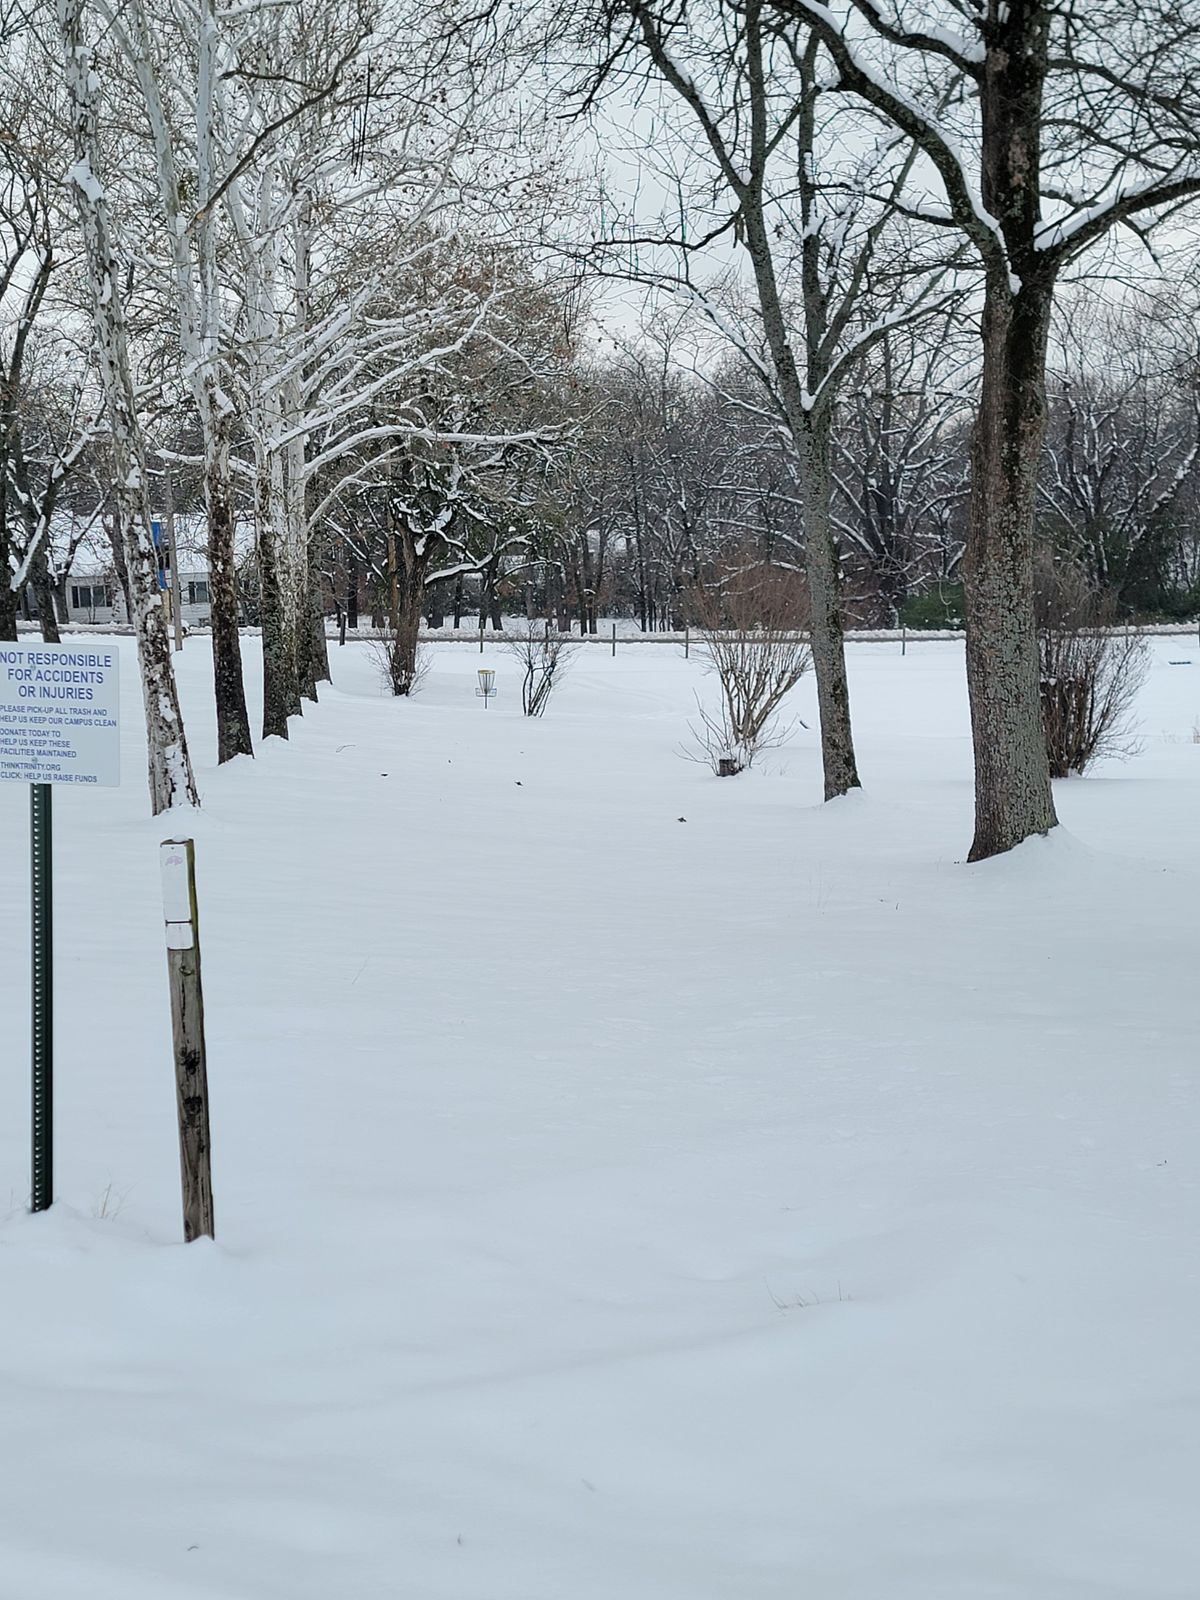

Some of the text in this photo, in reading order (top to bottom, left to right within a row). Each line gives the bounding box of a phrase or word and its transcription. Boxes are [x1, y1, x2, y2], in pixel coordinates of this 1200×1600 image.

[0, 651, 112, 668] NOT RESPONSIBLE
[8, 668, 104, 684] FOR ACCIDENTS
[18, 685, 93, 700] OR INJURIES
[0, 704, 107, 717] PLEASE PICK-UP ALL TRASH AND
[0, 715, 17, 723] HELP
[18, 715, 28, 723] US
[29, 716, 47, 725] KEEP
[64, 718, 93, 726] CAMPUS
[93, 719, 117, 727] CLEAN
[0, 728, 61, 738] DONATE TODAY TO
[0, 738, 71, 749] HELP US KEEP THESE
[0, 748, 77, 758] FACILITIES MAINTAINED
[0, 761, 61, 772] THINKTRINITY.ORG
[0, 771, 98, 783] CLICK: HELP US RAISE FUNDS
